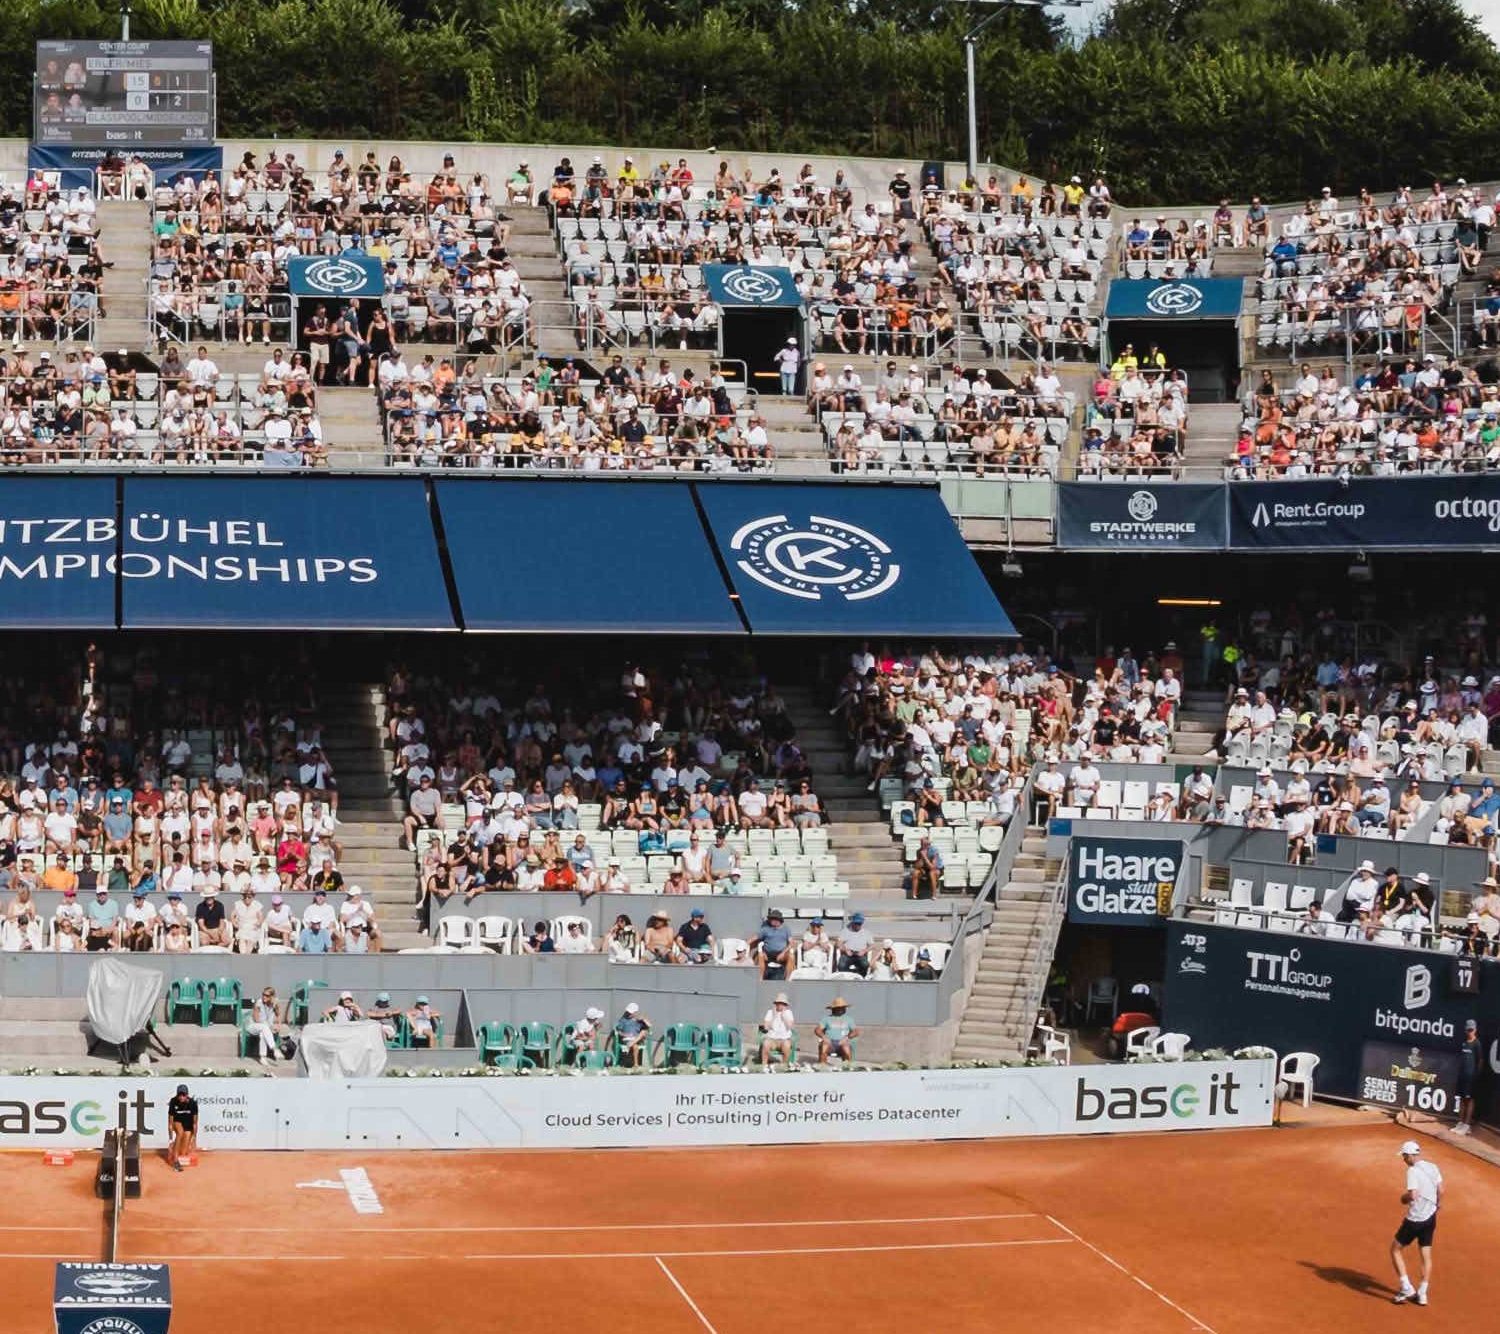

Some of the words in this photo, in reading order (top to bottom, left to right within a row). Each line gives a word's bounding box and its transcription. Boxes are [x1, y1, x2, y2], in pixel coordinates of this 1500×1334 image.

[1274, 502, 1365, 519] Rent.Group
[1090, 522, 1196, 532] STADTWERKE
[1078, 847, 1175, 883] Haare
[1126, 880, 1157, 895] statt
[1075, 883, 1157, 915] Glatze
[1287, 971, 1333, 988] GROUP
[1458, 970, 1473, 988] 17
[1244, 979, 1331, 1001] Personalmanagement
[1375, 1008, 1454, 1038] bitpanda
[1364, 1075, 1398, 1092] SERVE
[675, 1093, 696, 1106] Ihr
[701, 1090, 819, 1106] IT-Dienstleister
[823, 1090, 846, 1104] für
[1075, 1077, 1200, 1122] base
[1207, 1072, 1240, 1117] it
[1362, 1088, 1397, 1104] SPEED
[1405, 1084, 1447, 1112] 160
[118, 1090, 155, 1136] it
[222, 1108, 249, 1119] fast.
[545, 1114, 592, 1127] Cloud
[596, 1113, 663, 1127] Services
[675, 1110, 762, 1128] Consulting
[774, 1108, 873, 1124] On-Premises
[877, 1106, 962, 1121] Datacenter
[203, 1123, 249, 1133] secure.
